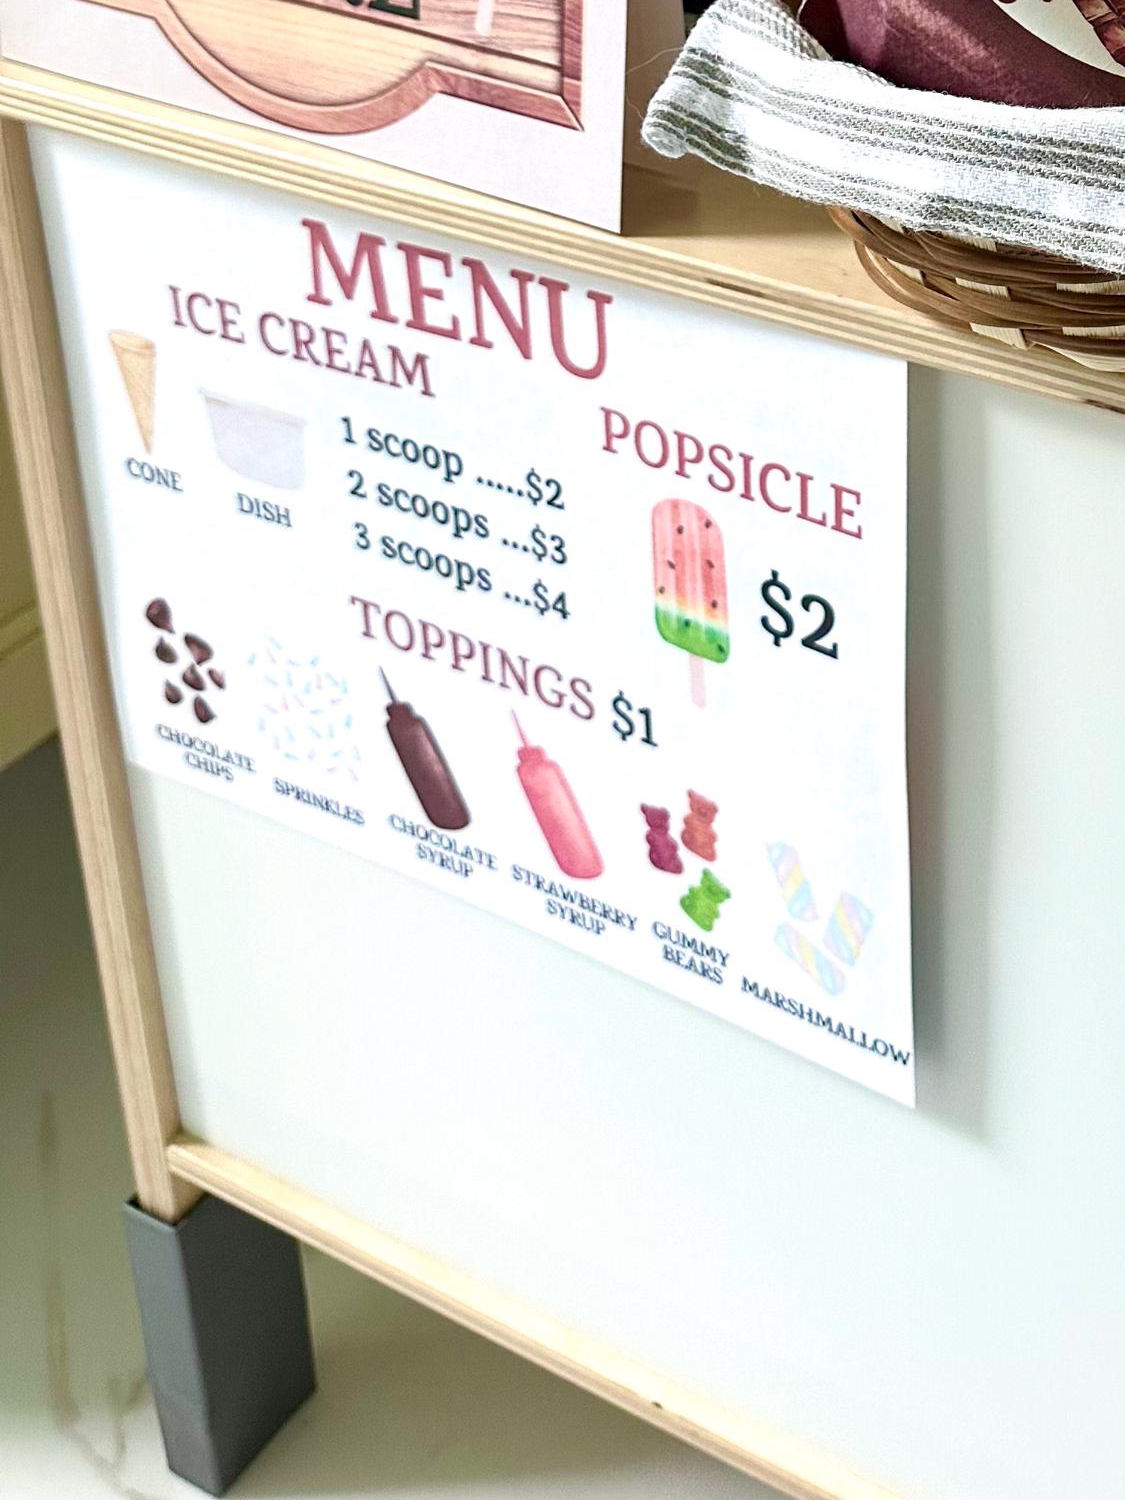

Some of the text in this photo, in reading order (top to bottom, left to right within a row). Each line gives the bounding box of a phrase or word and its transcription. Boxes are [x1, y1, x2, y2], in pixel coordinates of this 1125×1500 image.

[301, 218, 613, 379] MENU
[169, 285, 435, 398] ICE CREAM
[126, 456, 183, 492] CONE
[341, 416, 357, 444] 1
[366, 427, 463, 483] scoop
[600, 406, 863, 539] POPSICLE
[236, 492, 292, 527] DISH
[347, 469, 368, 499] 2
[377, 482, 490, 538] scoops
[353, 521, 371, 550] 3
[381, 535, 493, 591] scoops
[760, 570, 839, 659] $2
[350, 595, 658, 747] TOPPINGS $1
[156, 724, 256, 773] CHOCOLATE
[184, 751, 235, 782] CHIPS
[273, 778, 366, 826] SPRINKLES
[388, 813, 498, 871] CHOCOLATE
[416, 842, 474, 877] SYRUP
[512, 863, 638, 931] STRAWBERRY
[546, 898, 607, 936] SYRUP
[652, 921, 730, 968] GUMMY
[662, 944, 724, 985] BEARS
[740, 976, 911, 1066] MARSHMALLOW
